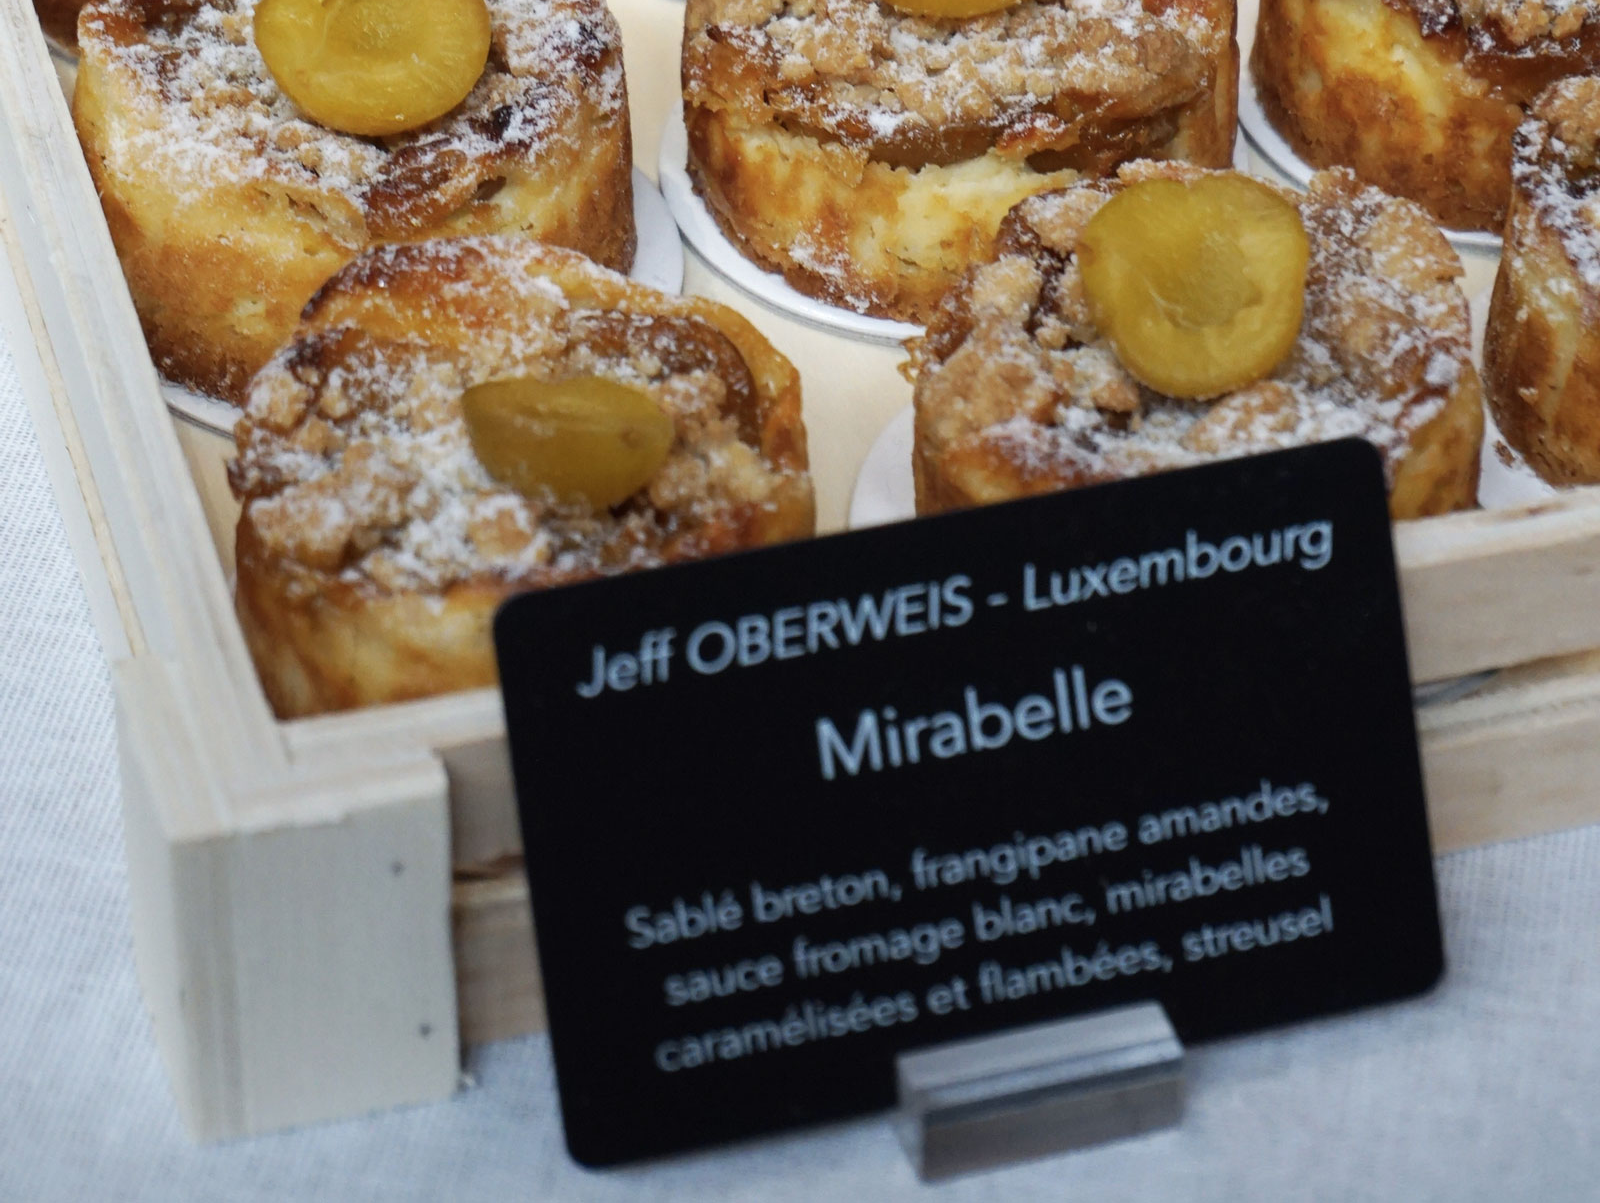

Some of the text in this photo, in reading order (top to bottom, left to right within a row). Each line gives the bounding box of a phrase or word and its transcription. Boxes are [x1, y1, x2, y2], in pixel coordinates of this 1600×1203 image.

[576, 519, 1333, 698] Jeff OBERWEIS - Luxembourg
[817, 663, 1134, 778] Mirabelle
[624, 777, 1329, 949] Sablé breton, frangipane amandes,
[664, 843, 1311, 1006] sauce fromage blanc, mirabelles
[655, 891, 1334, 1072] caramélisées et flambées, streusel
